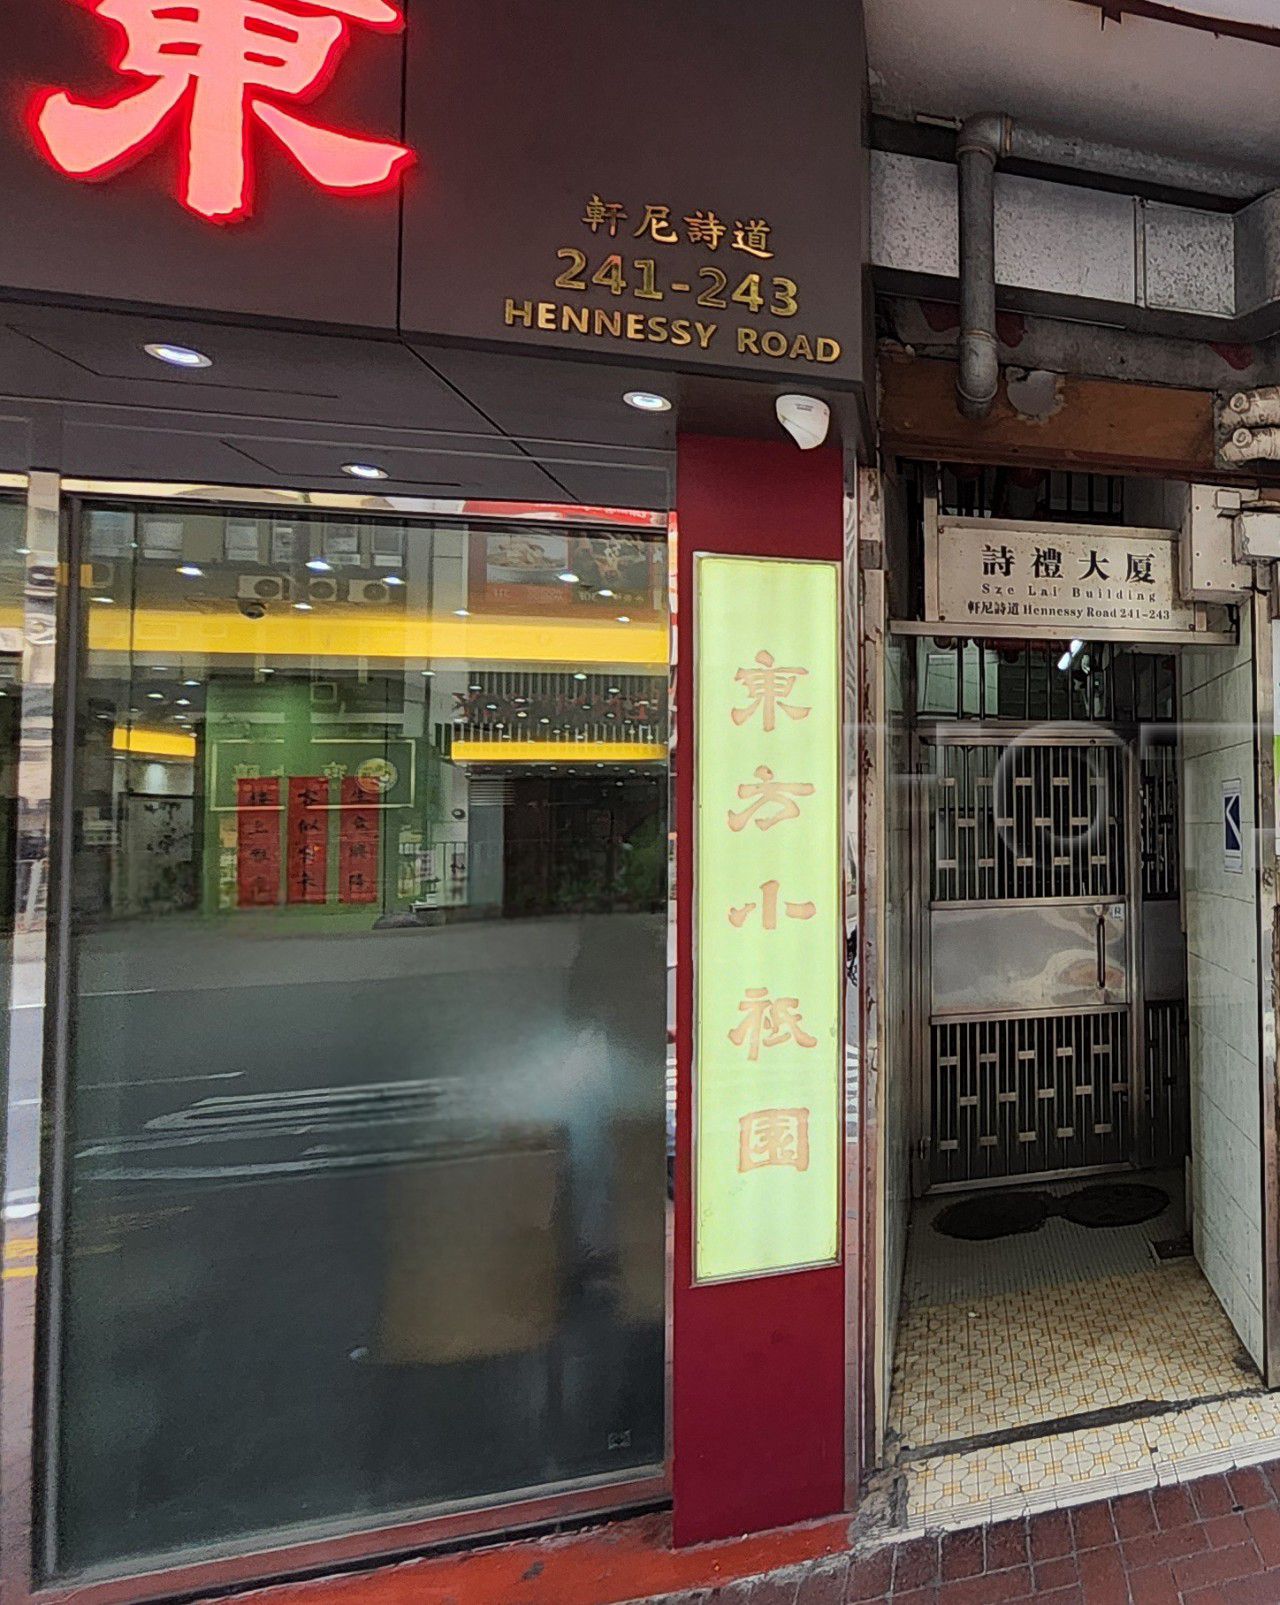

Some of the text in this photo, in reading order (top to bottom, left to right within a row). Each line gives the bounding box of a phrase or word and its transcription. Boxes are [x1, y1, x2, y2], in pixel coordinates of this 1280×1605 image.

[581, 192, 776, 260] 軒尼詩道
[553, 247, 801, 318] 241-243
[503, 298, 843, 364] HENNESSY ROAD
[967, 600, 1171, 620] 軒尼詩道 Hennessy Road 241-243
[981, 583, 1157, 602] Sze Lai Building
